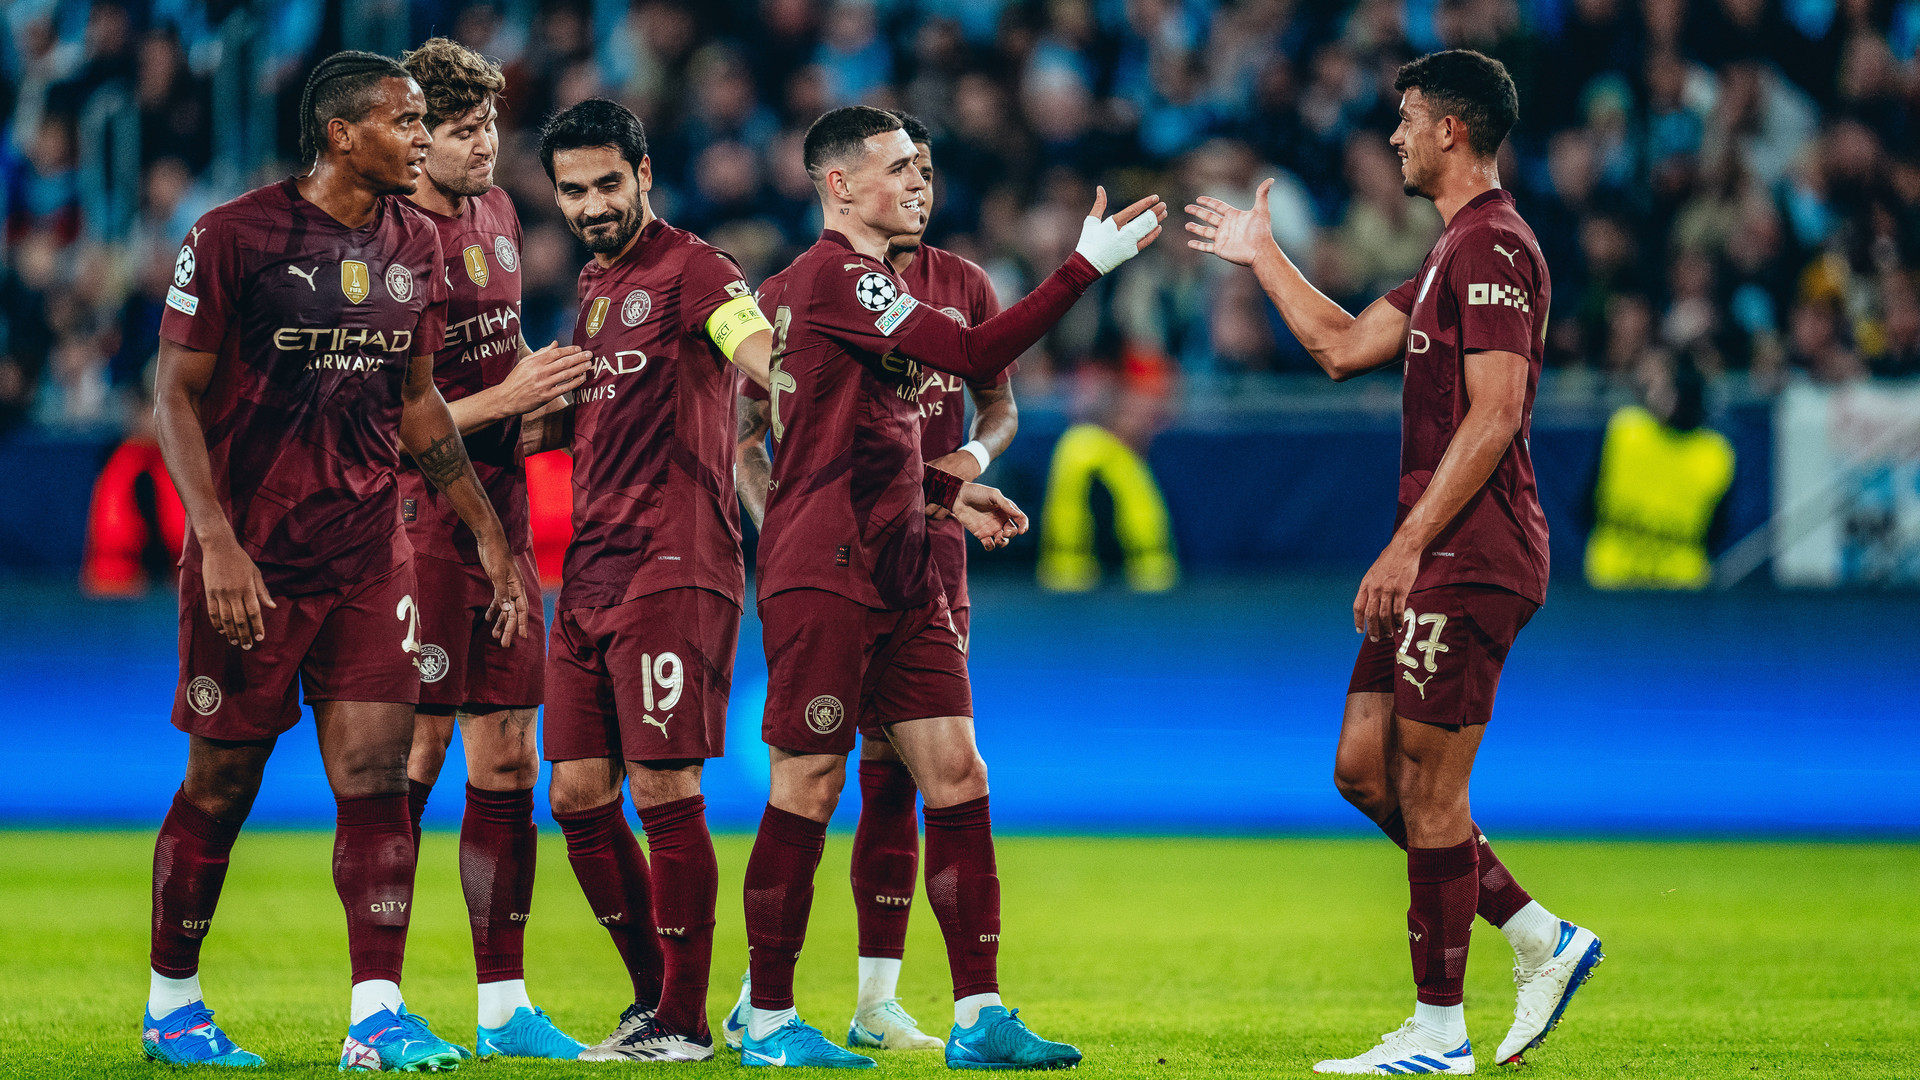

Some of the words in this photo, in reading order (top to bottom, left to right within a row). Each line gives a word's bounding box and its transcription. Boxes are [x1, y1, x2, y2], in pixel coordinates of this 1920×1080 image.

[839, 208, 850, 216] 47
[273, 327, 412, 353] ETIHAD
[302, 354, 384, 372] AIRWAYS
[1396, 607, 1449, 673] 27
[641, 651, 684, 712] 19
[370, 901, 407, 913] CITY
[875, 894, 911, 906] CITY
[979, 934, 1000, 943] CITY
